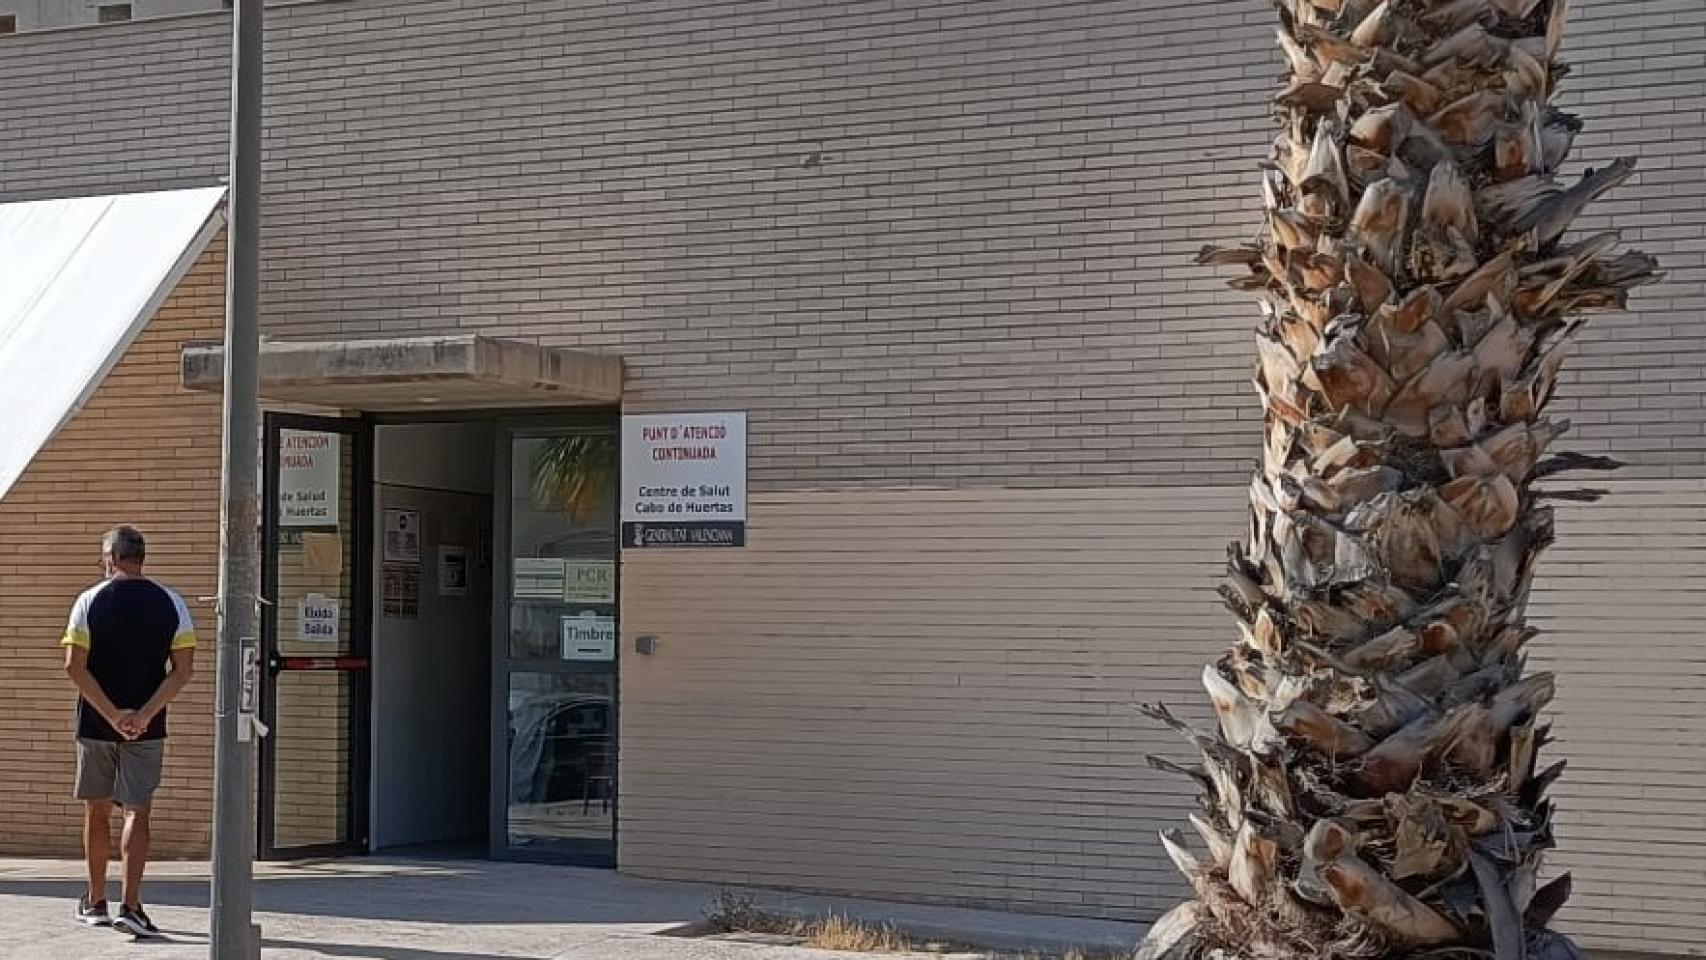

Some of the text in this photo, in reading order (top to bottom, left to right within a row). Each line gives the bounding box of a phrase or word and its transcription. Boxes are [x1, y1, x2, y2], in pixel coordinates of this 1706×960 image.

[643, 427, 667, 440] PUNT
[652, 447, 717, 461] CONTINUADA
[296, 489, 325, 501] Salud
[639, 484, 730, 497] Centre de Salut
[635, 501, 733, 513] Cabo de Huertas
[304, 623, 333, 635] Salida
[567, 625, 614, 641] Timbre
